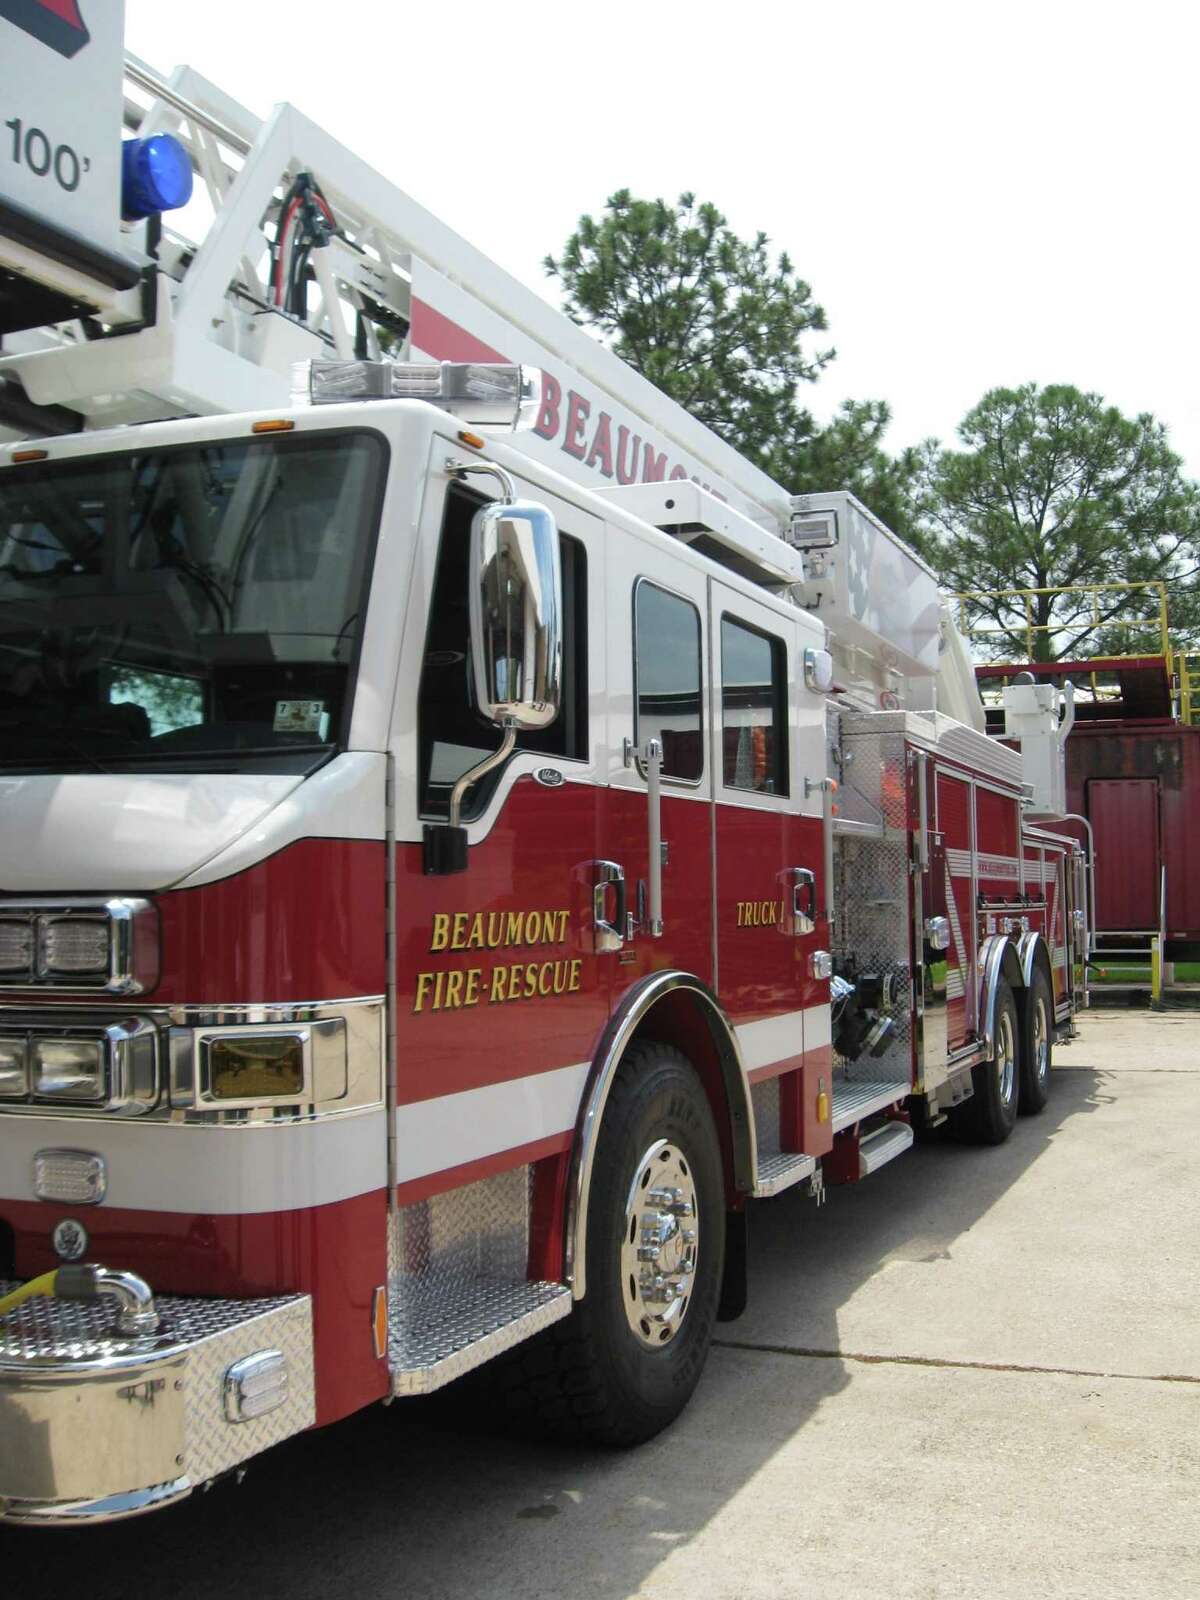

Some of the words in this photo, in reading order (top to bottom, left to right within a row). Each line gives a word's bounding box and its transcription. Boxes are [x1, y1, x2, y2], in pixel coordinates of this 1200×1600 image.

[5, 118, 91, 192] 100'
[533, 368, 728, 502] BEAUM
[429, 910, 570, 952] BEAUMONT
[736, 901, 777, 927] TRUCK
[413, 959, 582, 1014] FIRE-RESCUE
